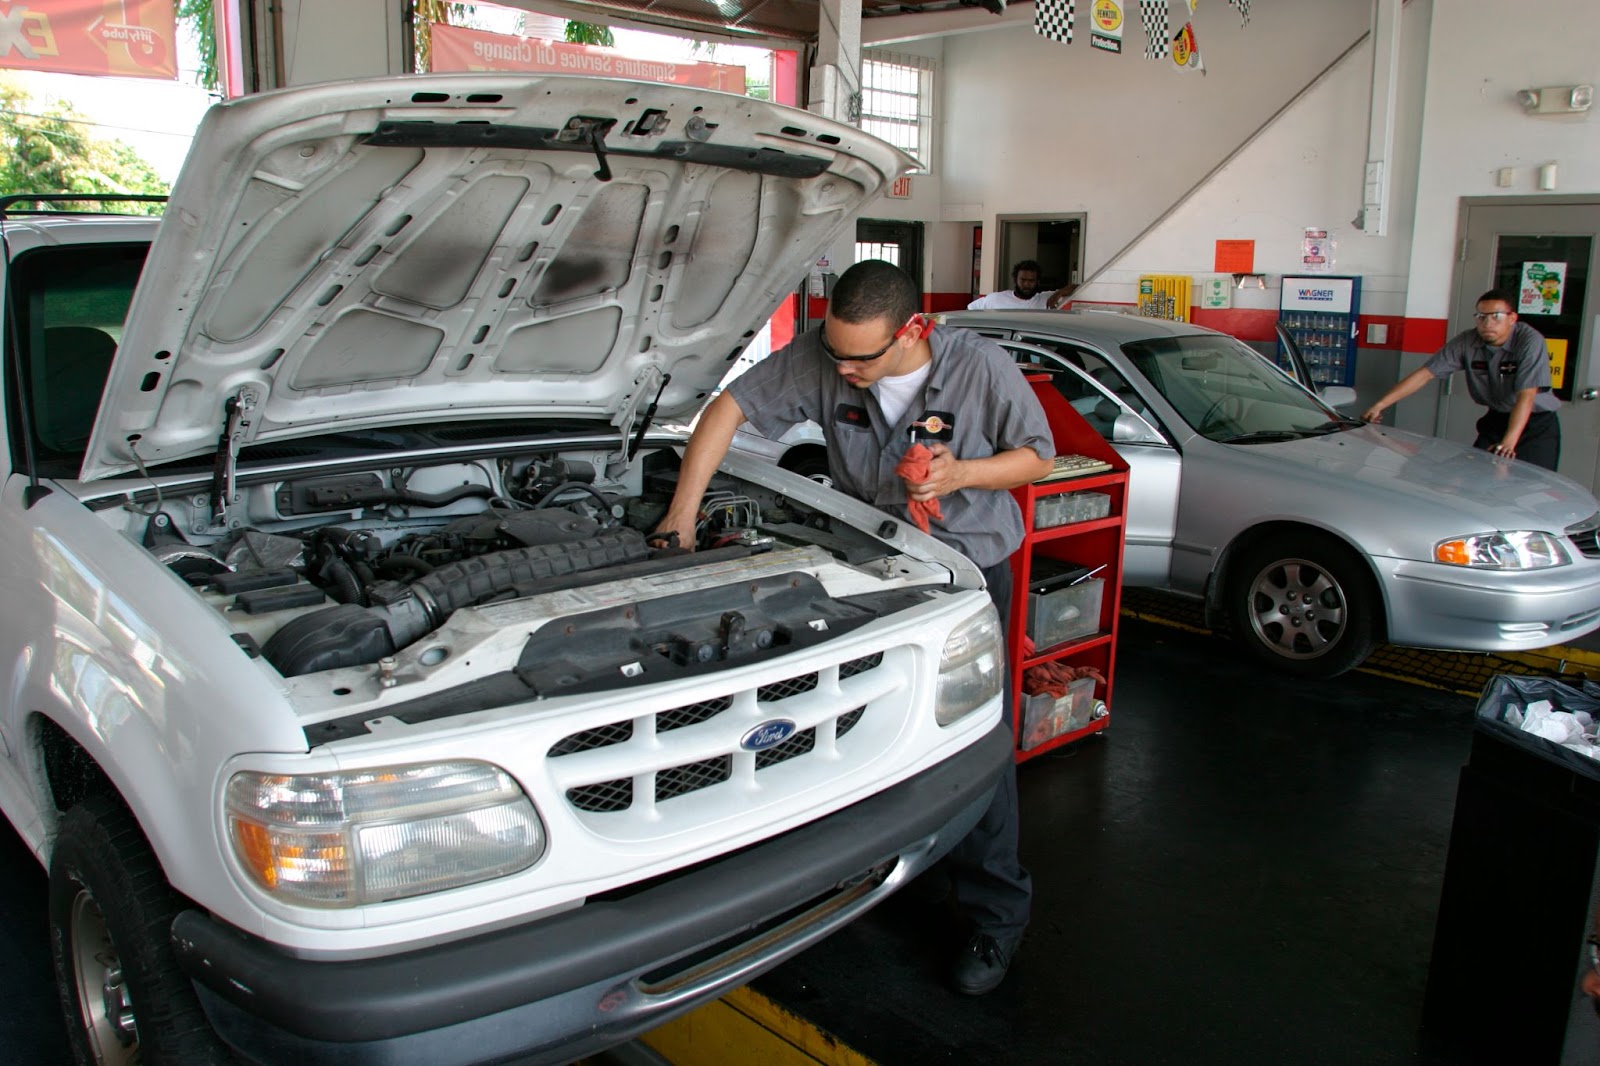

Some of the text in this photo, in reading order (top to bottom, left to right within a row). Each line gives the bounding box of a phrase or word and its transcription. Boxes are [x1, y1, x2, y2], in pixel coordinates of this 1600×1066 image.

[1097, 9, 1118, 20] PENNZOIL
[893, 177, 911, 196] EXIT
[1298, 289, 1333, 297] WAGNER
[755, 726, 784, 745] Ford
